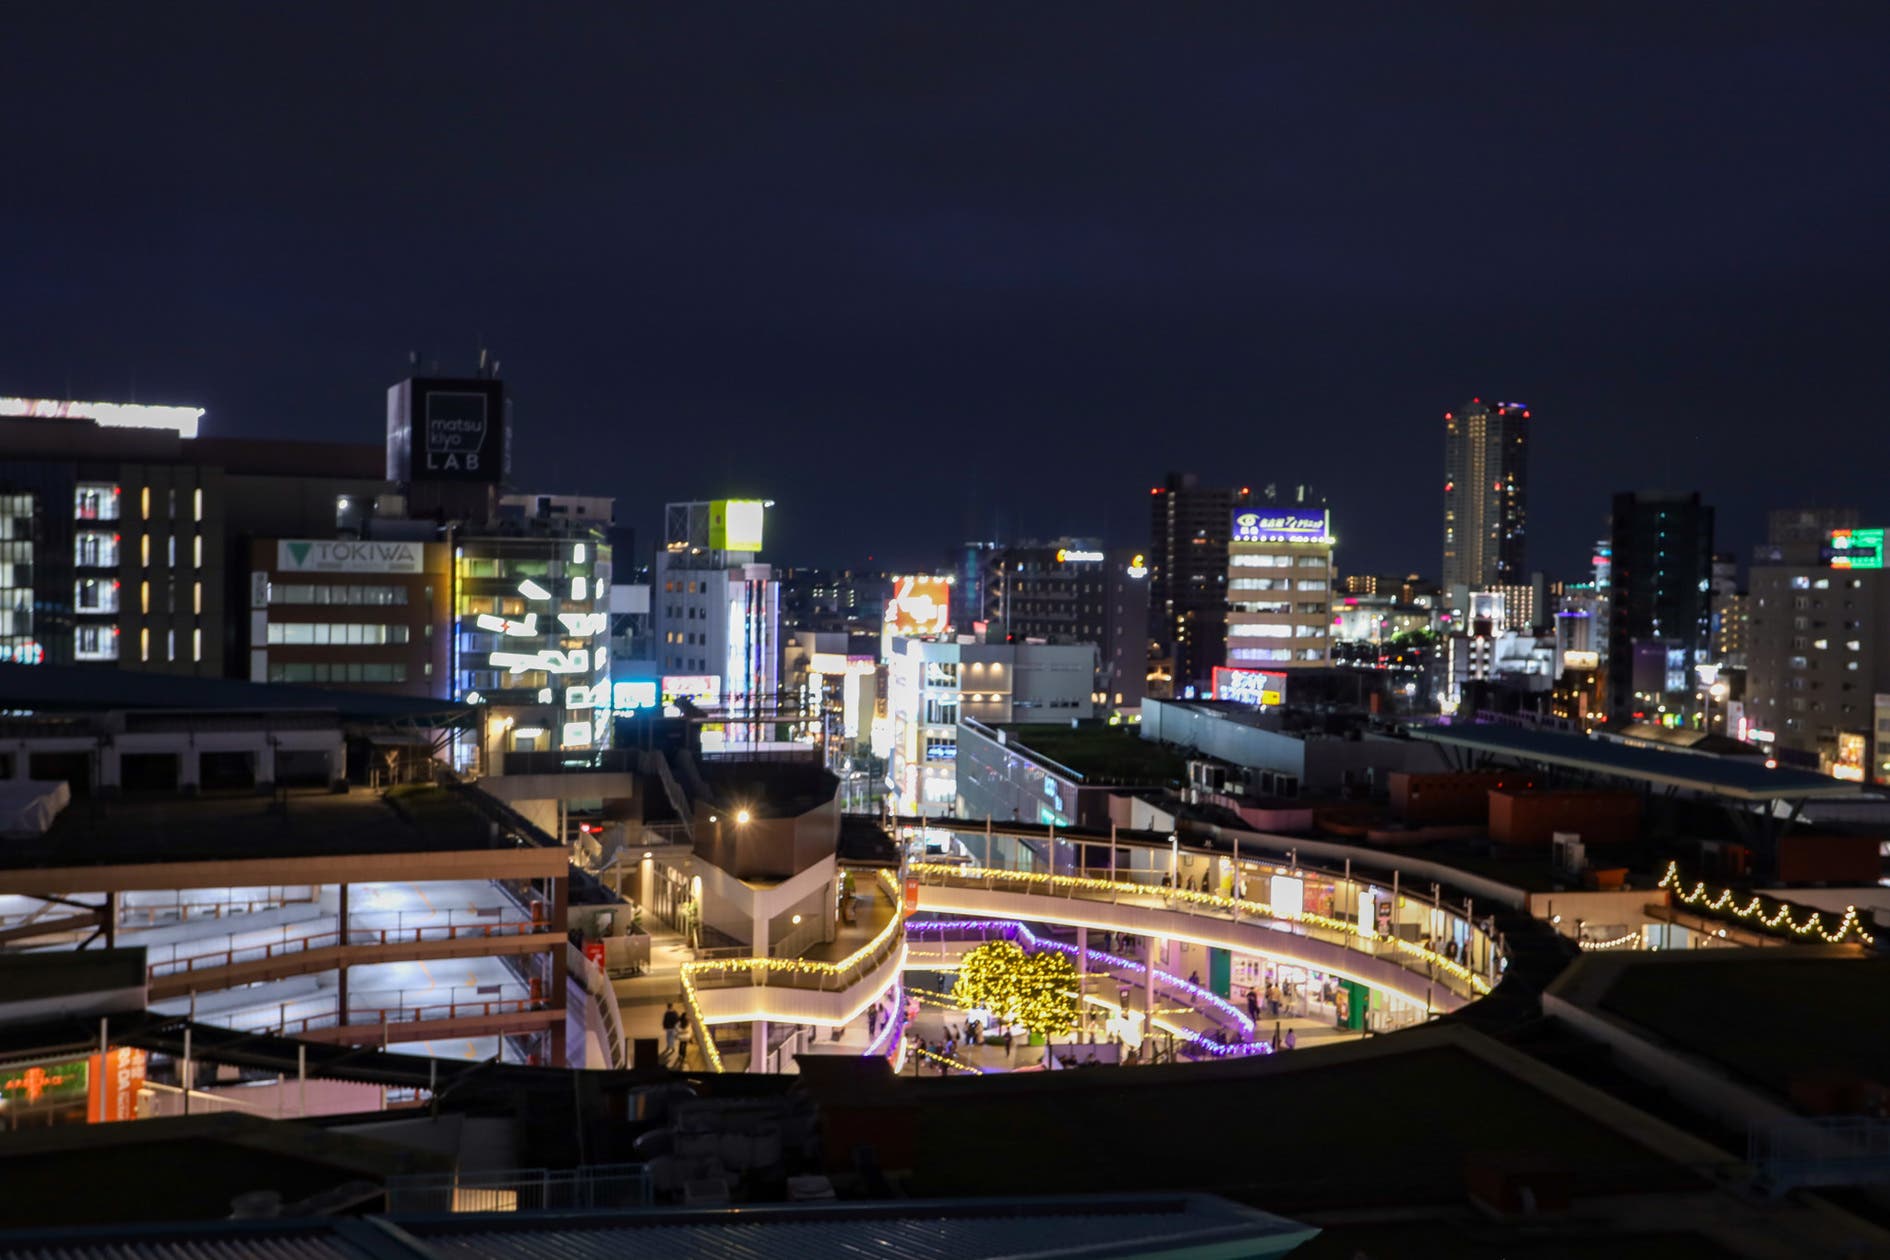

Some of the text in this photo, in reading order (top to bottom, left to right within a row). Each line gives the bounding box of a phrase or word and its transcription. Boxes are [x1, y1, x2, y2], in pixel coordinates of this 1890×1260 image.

[431, 418, 482, 433] matsu
[431, 433, 462, 453] kiyo
[426, 453, 480, 471] LAB
[315, 543, 415, 561] TOKIWA
